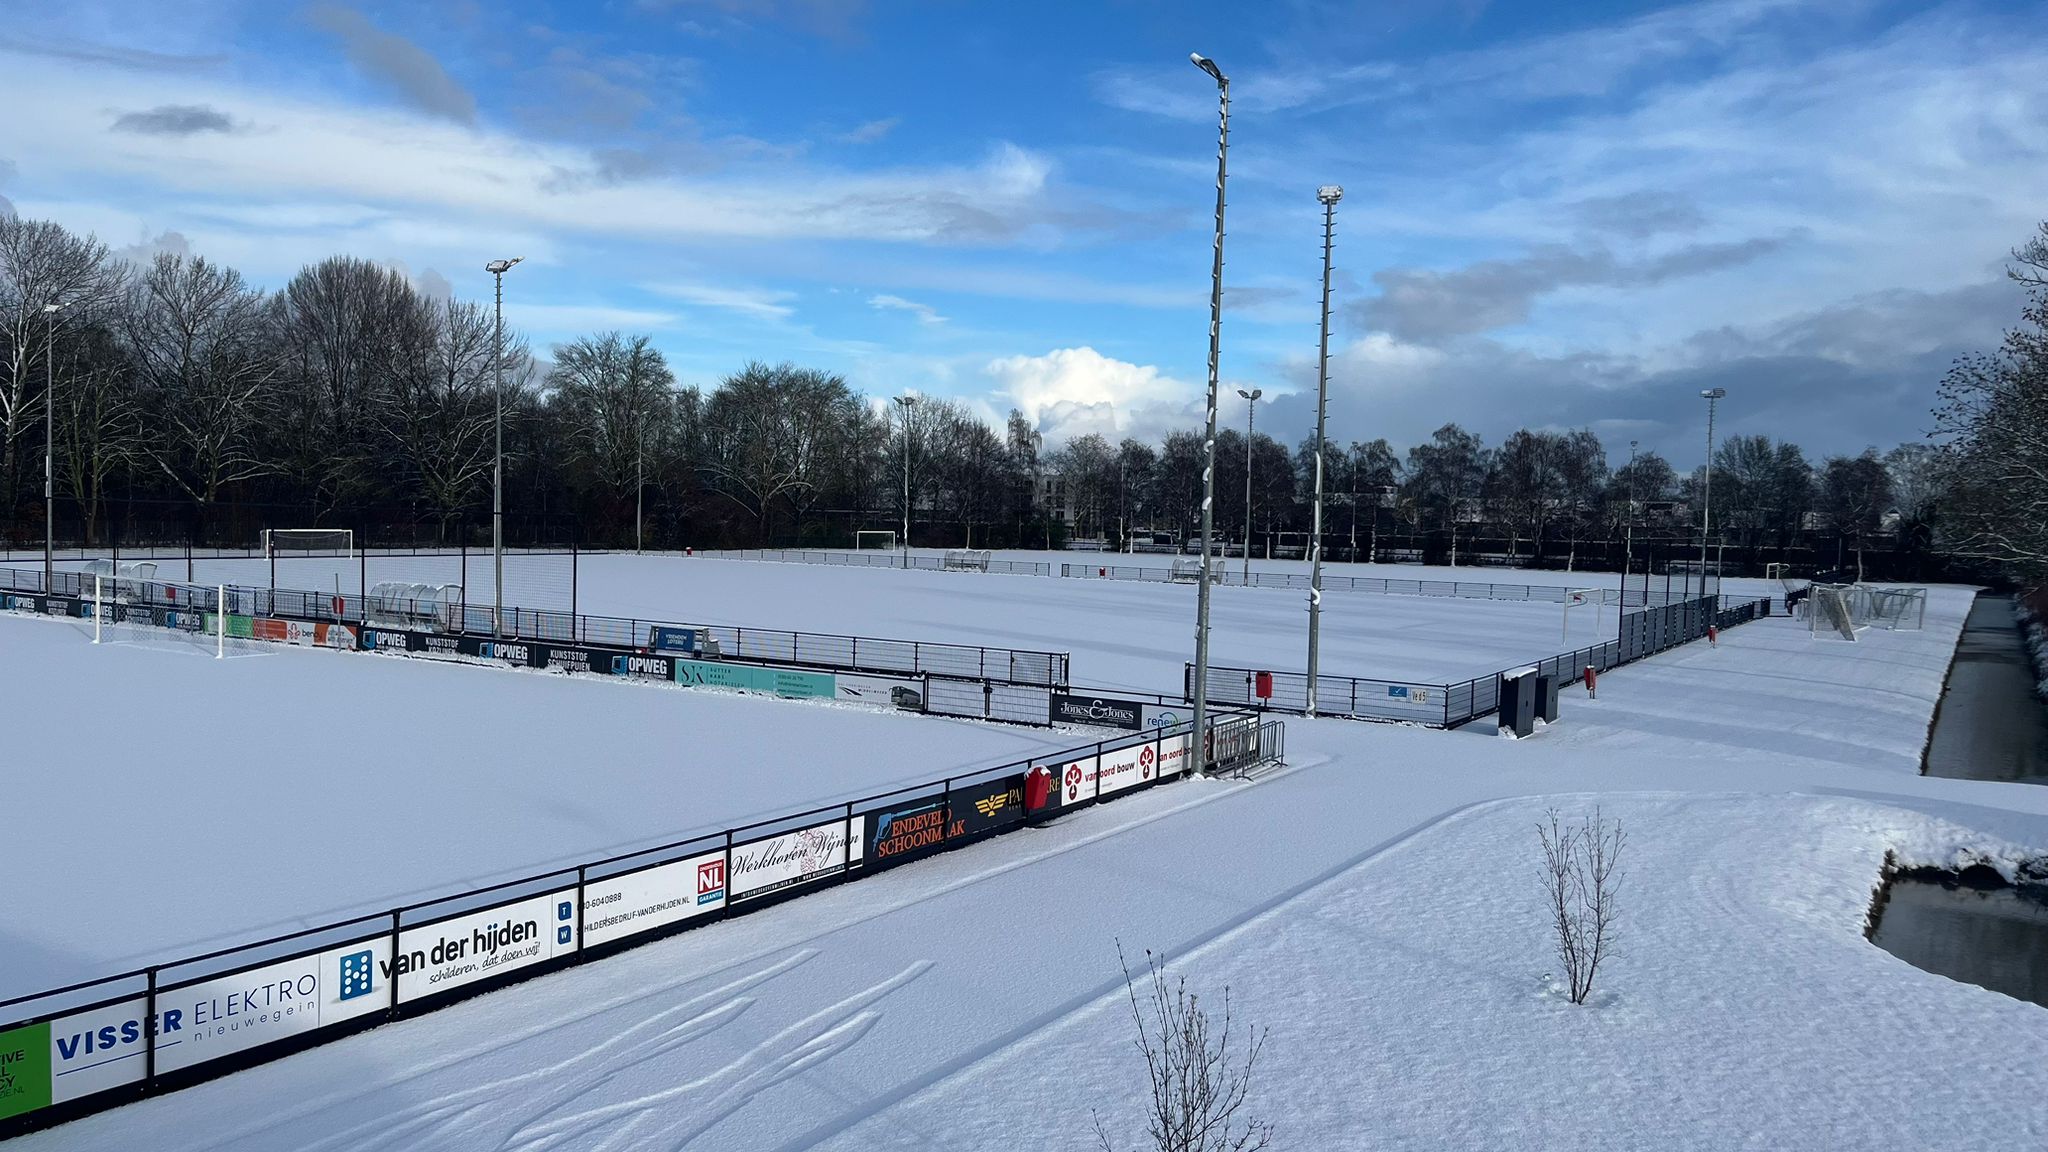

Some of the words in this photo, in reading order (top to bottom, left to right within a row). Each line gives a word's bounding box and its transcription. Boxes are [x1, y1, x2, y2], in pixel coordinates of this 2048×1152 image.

[91, 604, 112, 617] OWEG
[376, 631, 406, 647] OPWEG
[425, 637, 459, 648] KUNSTSTOF
[494, 644, 528, 660] OPWEG
[550, 650, 588, 661] KUNSTSTOF
[628, 656, 668, 675] OPWEG
[1159, 752, 1168, 762] an
[1169, 747, 1183, 758] oord
[1099, 763, 1116, 778] oord
[1116, 761, 1135, 774] bouw
[878, 819, 965, 859] SCHOONMAK
[699, 866, 723, 892] NL
[379, 949, 426, 980] van
[431, 937, 469, 965] der
[473, 919, 537, 955] hijden
[482, 955, 499, 969] dat
[501, 949, 523, 964] doen
[56, 1008, 183, 1061] VISSER
[195, 974, 317, 1026] ELEKTRO
[194, 1001, 315, 1042] nieuwegein
[0, 1049, 25, 1065] IVE
